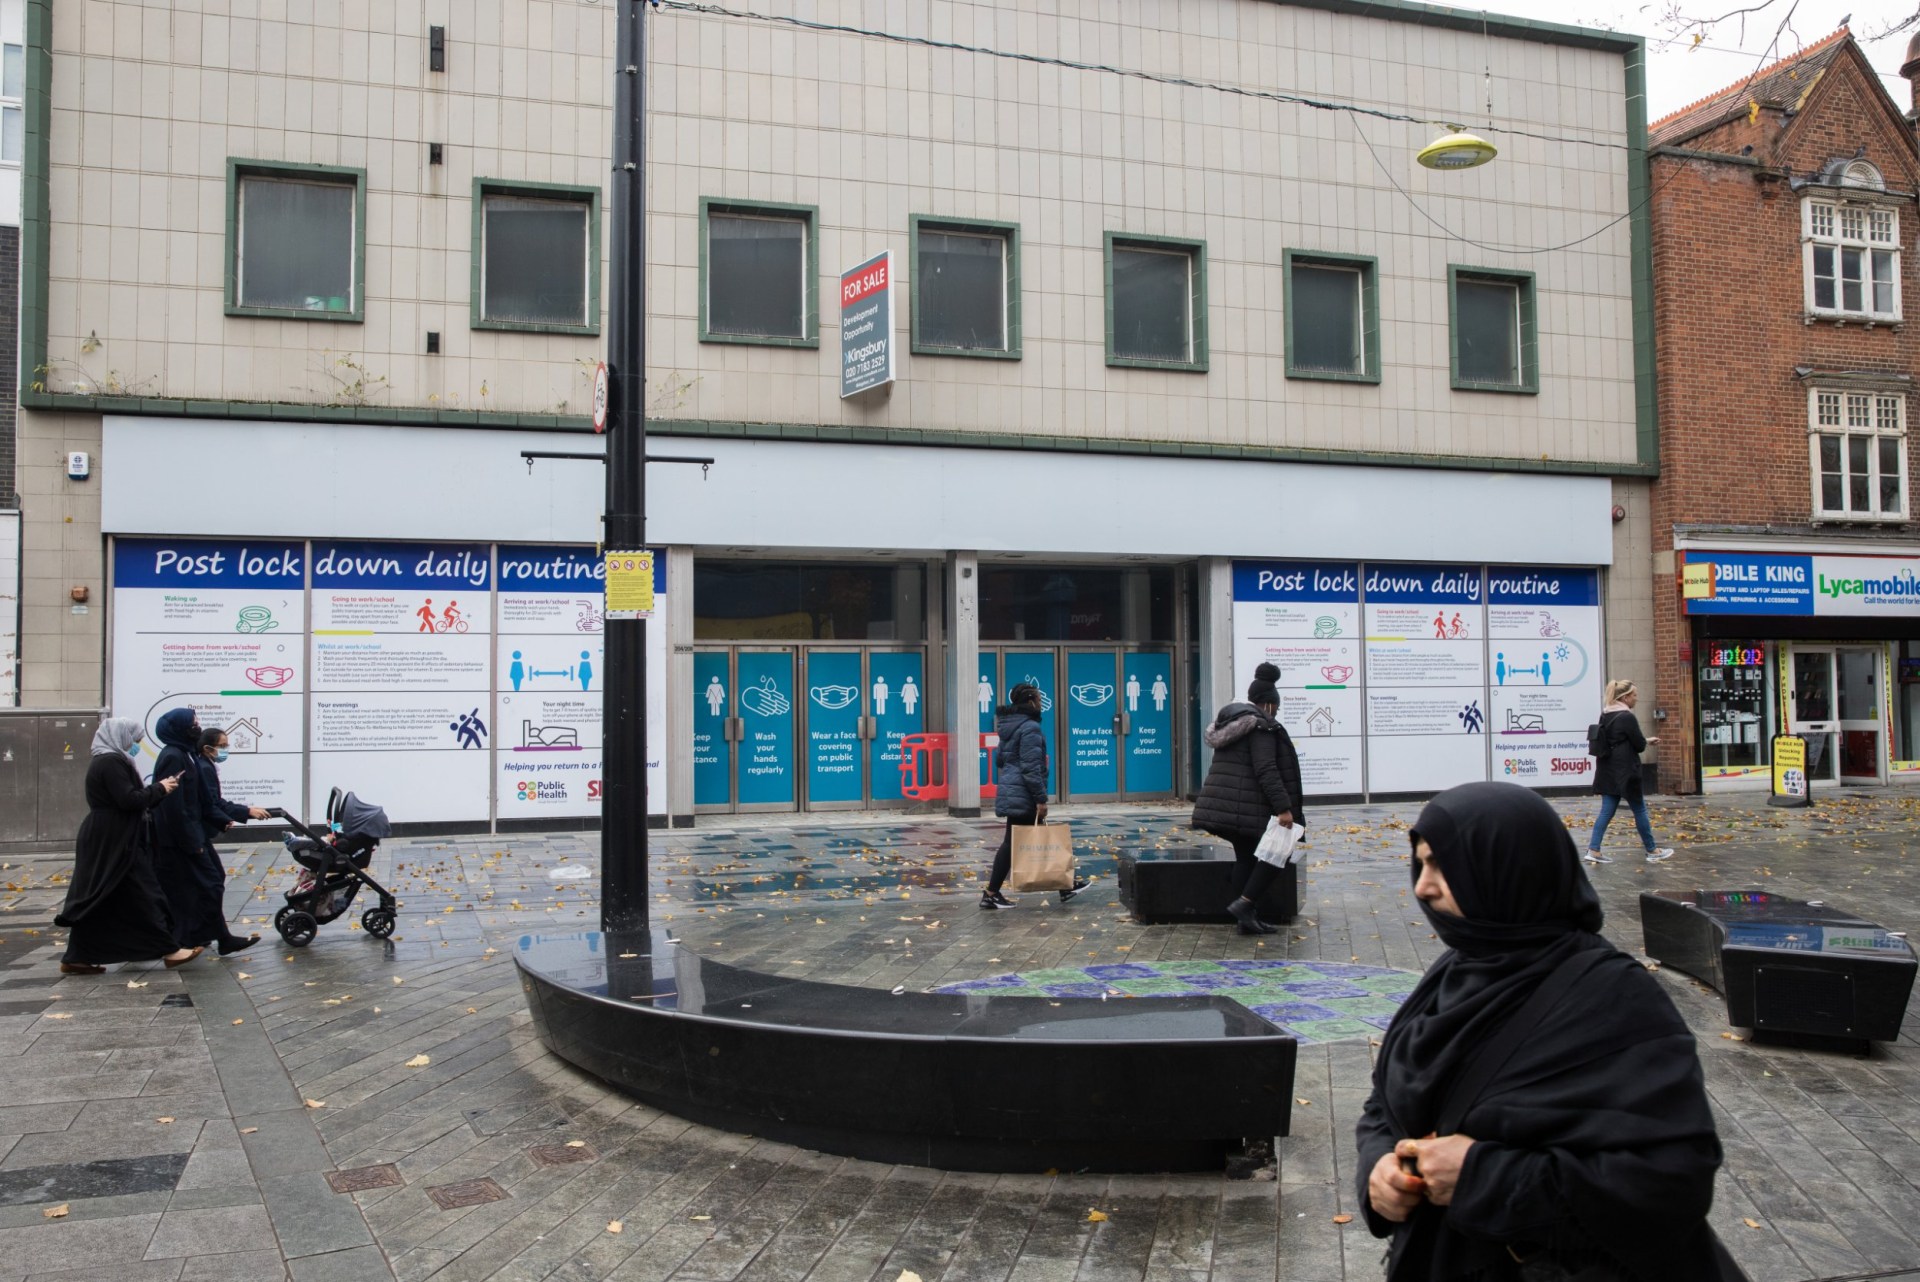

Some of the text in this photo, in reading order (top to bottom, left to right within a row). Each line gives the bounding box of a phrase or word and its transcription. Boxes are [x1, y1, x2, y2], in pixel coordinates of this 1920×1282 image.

[844, 268, 885, 301] FOR SALE
[844, 304, 878, 327] Development
[844, 321, 874, 341] Opportunity
[848, 338, 887, 364] Kingsbury
[846, 366, 856, 379] 020
[857, 360, 870, 375] 7183
[155, 548, 606, 586] Post lock down daily routine
[1715, 564, 1805, 583] OBILE KING
[1258, 568, 1560, 601] Post lock down daily routine
[1819, 571, 1920, 598] Lycamobile
[755, 732, 776, 740] Wash
[840, 731, 857, 740] face
[887, 731, 906, 741] Keep
[1098, 728, 1113, 736] face
[1138, 727, 1156, 736] Keep
[818, 742, 852, 753] covering
[887, 743, 902, 751] you
[1077, 738, 1108, 748] covering
[756, 744, 775, 753] your
[1088, 748, 1109, 758] public
[1133, 748, 1162, 756] distance
[754, 754, 778, 763] hands
[830, 753, 853, 763] public
[504, 762, 535, 774] Helping
[537, 764, 552, 773] you
[817, 764, 854, 774] transport
[1076, 759, 1109, 769] transport
[1551, 757, 1592, 774] Slough
[748, 766, 784, 776] regularly
[537, 782, 565, 790] Public
[537, 790, 568, 799] Health
